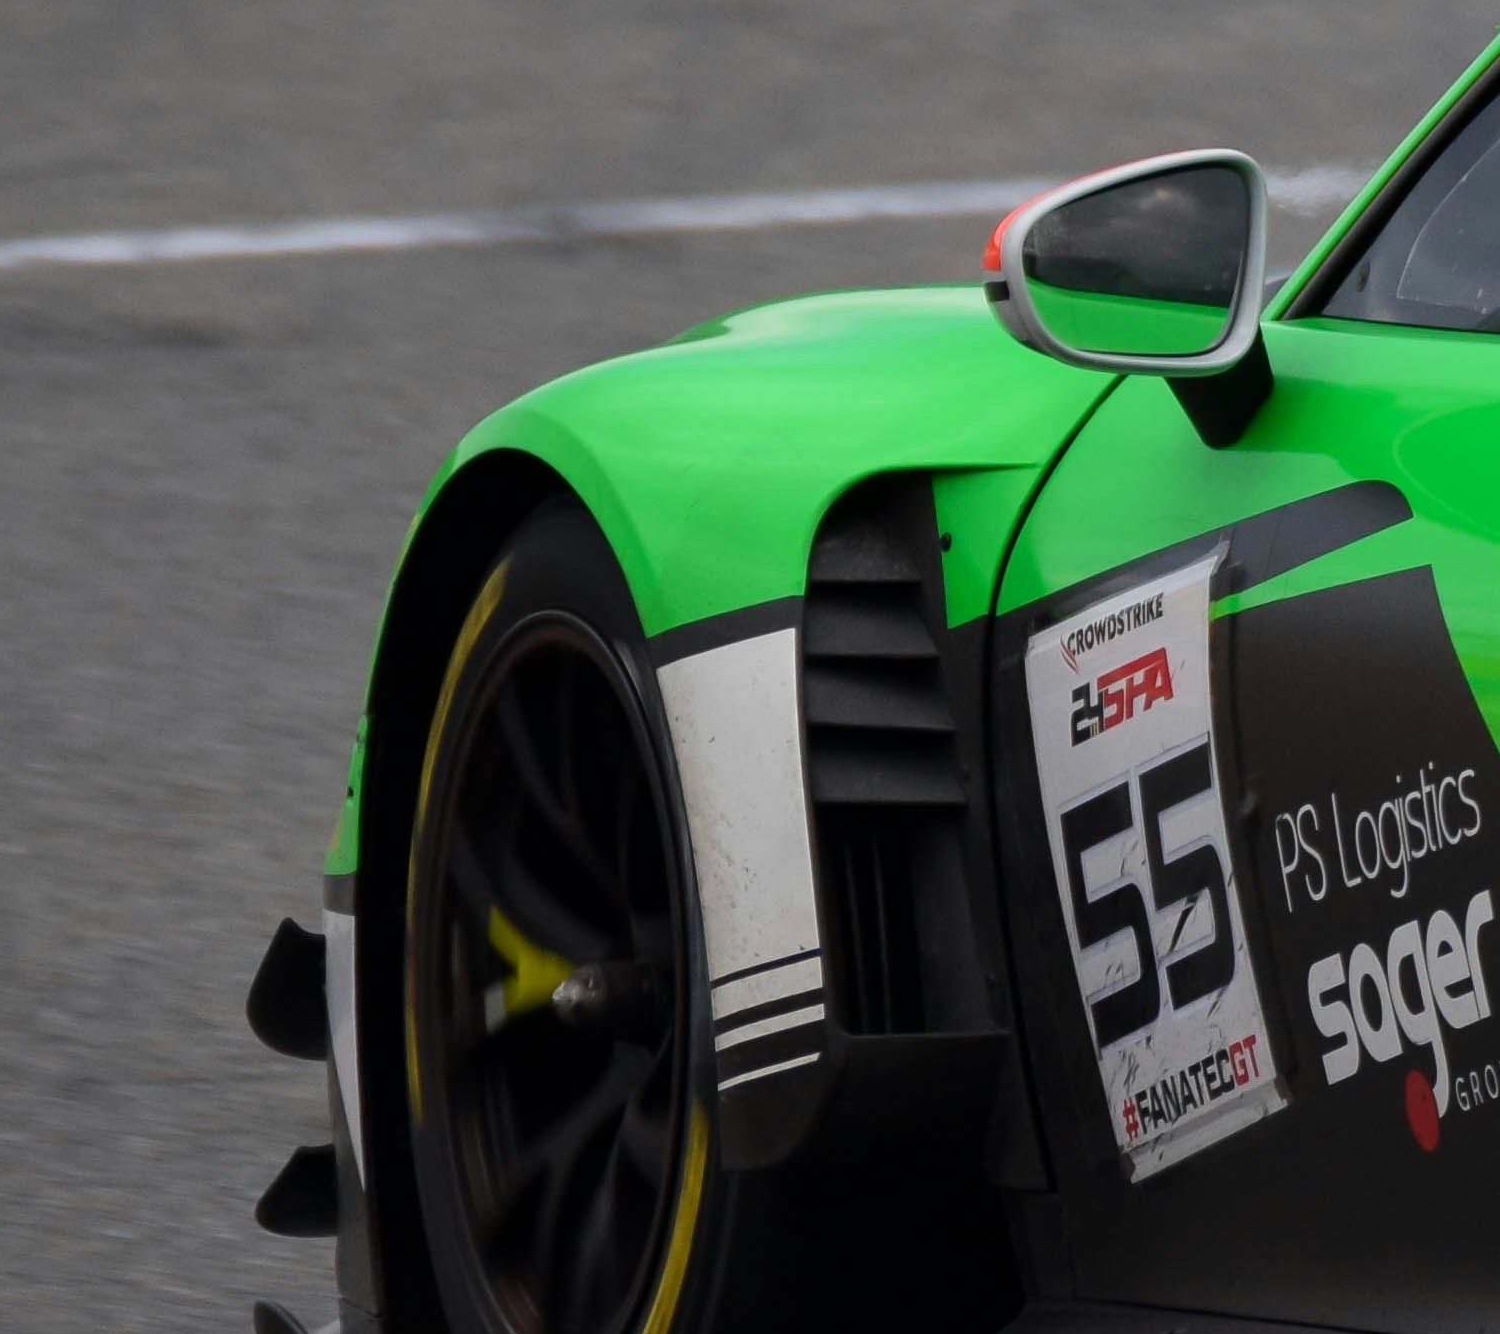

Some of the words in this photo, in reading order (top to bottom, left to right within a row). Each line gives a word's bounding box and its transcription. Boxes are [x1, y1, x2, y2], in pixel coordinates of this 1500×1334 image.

[1066, 592, 1165, 657] CROWDSTRIKE
[1059, 732, 1238, 1050] 55
[1274, 803, 1328, 913] PS
[1331, 761, 1483, 899] Logistics
[1307, 889, 1495, 1119] sager
[1121, 1034, 1258, 1142] #FANATECGT
